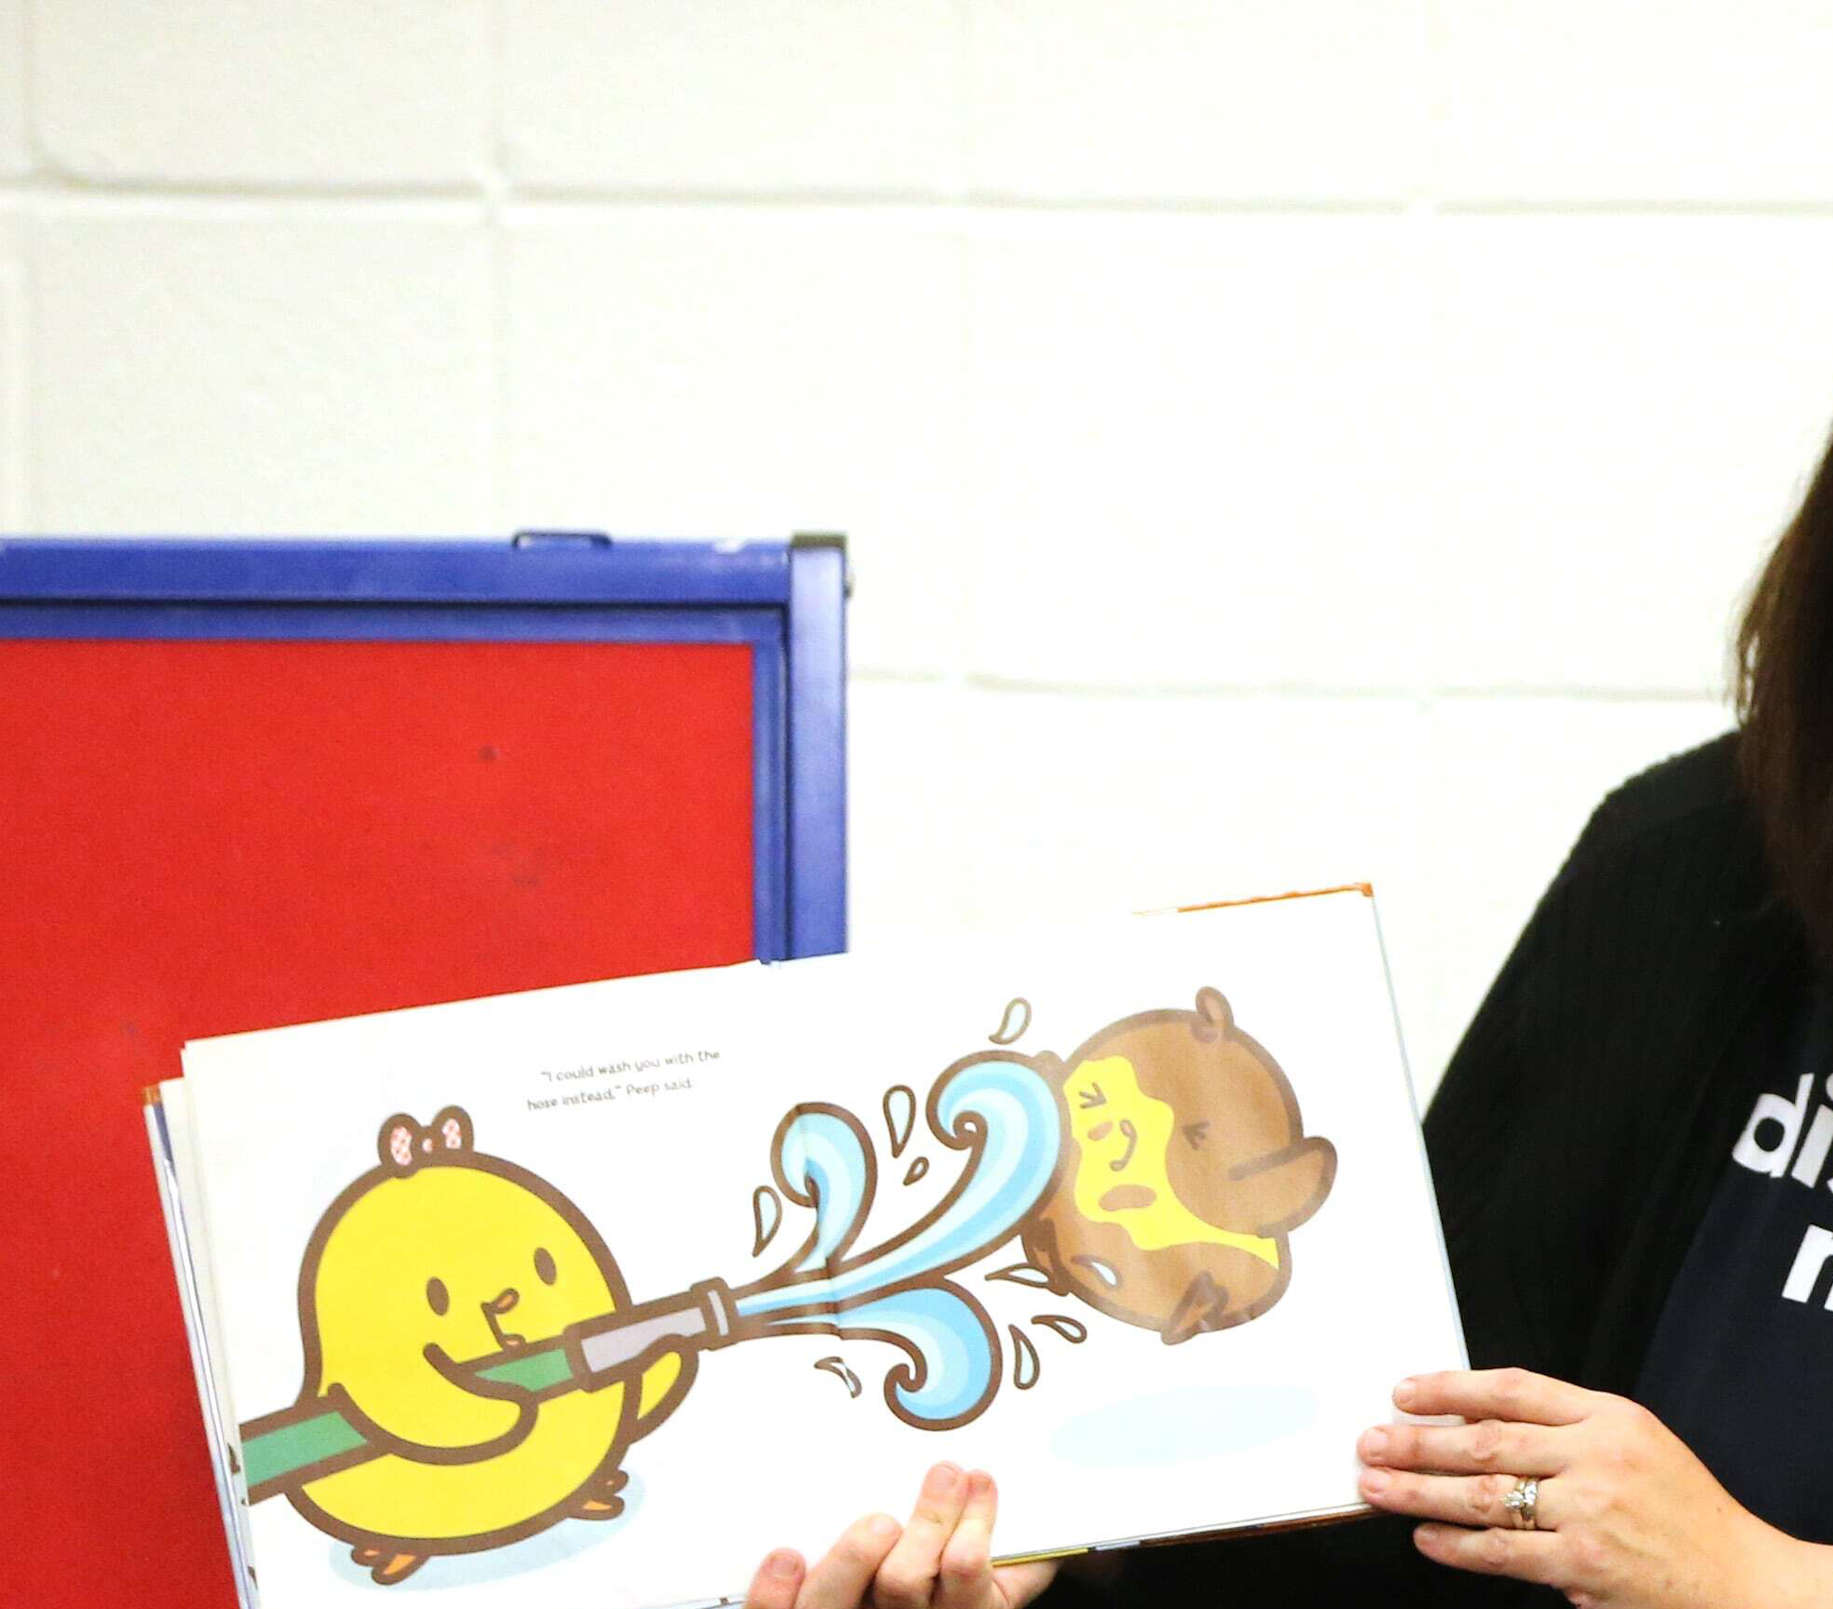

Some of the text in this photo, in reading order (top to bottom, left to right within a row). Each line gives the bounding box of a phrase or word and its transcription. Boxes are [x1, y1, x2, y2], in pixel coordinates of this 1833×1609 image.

[556, 1065, 594, 1082] could
[598, 1059, 631, 1075] wash
[634, 1058, 661, 1072] you
[664, 1052, 693, 1066] with
[697, 1049, 720, 1062] the
[527, 1098, 558, 1111] hose
[626, 1082, 660, 1096] Peep
